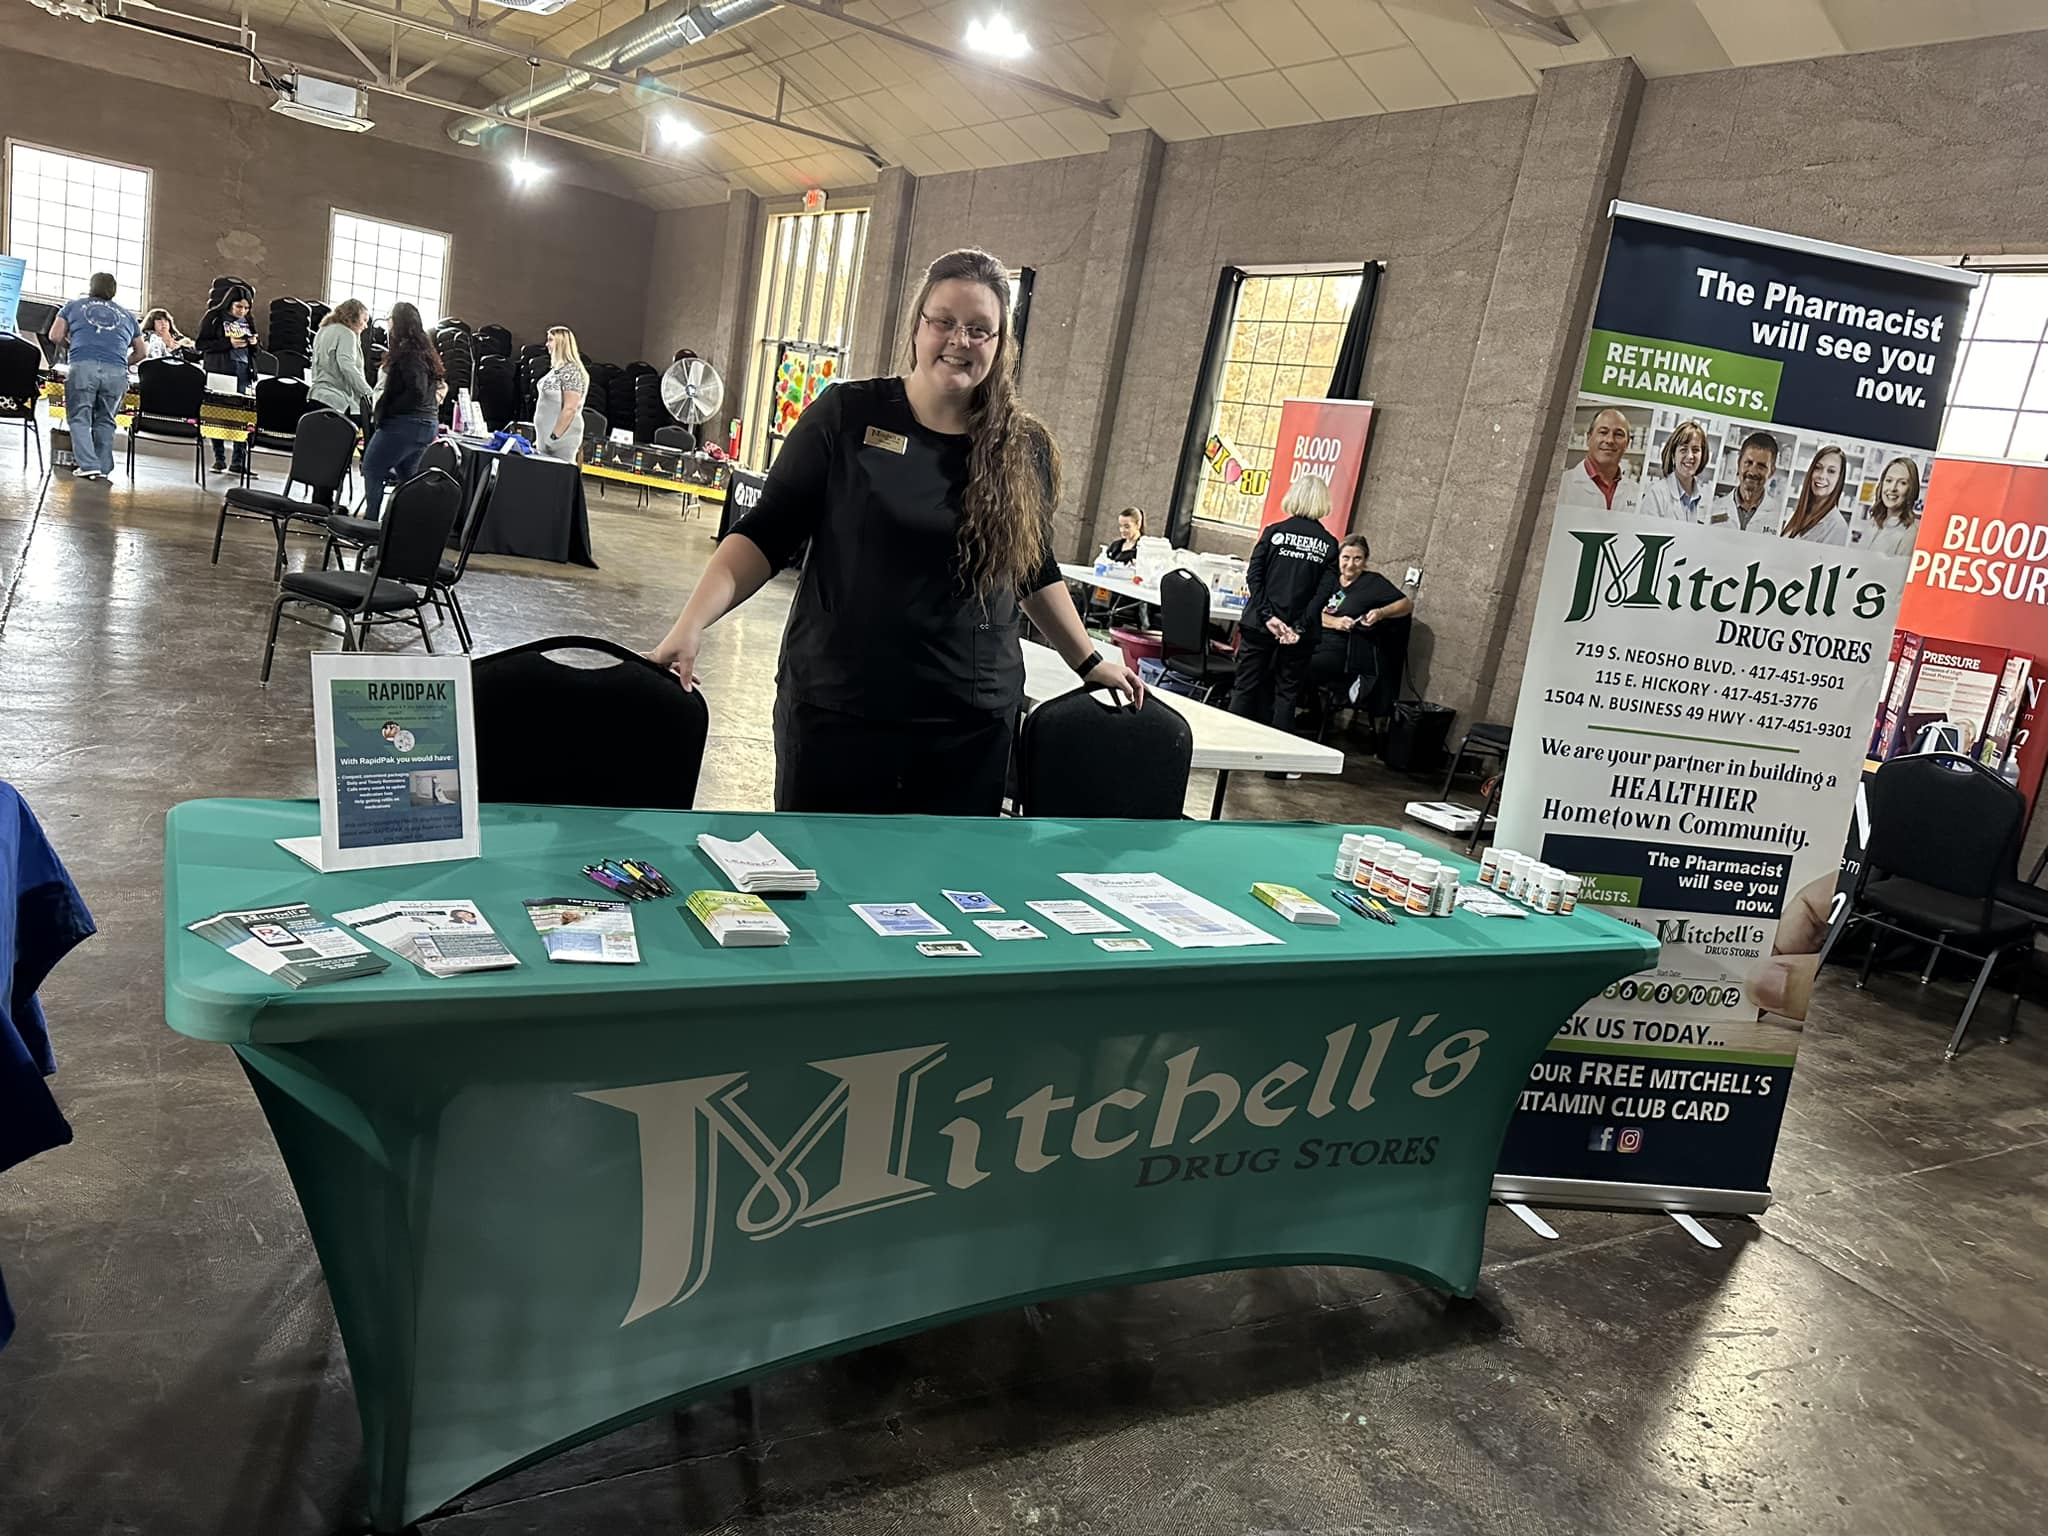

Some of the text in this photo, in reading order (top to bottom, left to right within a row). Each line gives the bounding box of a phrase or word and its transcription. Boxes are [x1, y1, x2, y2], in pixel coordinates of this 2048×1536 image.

[1696, 267, 1944, 343] The Pharmacist
[1606, 343, 1712, 378] RETHINK
[1751, 320, 1936, 376] will see you
[1601, 365, 1769, 412] PHARMACISTS.
[1856, 374, 1927, 409] now.
[1293, 435, 1341, 462] BLOOD
[1284, 532, 1330, 553] FREEMAN
[1943, 514, 2048, 562] BLOOD
[1564, 530, 1887, 623] Mitchell's
[1906, 549, 2048, 605] PRESSUR
[1716, 619, 1872, 664] DRUG STORES
[1575, 642, 1845, 690] 719 S. NEOSHO BLVD. 417-451-9501
[1921, 650, 1982, 670] PRESSURE
[368, 683, 447, 701] RAPIDPAK
[1595, 670, 1819, 711] 115 E. HICKORY 417-451-3776
[1544, 688, 1852, 739] 1504 N. BUSINESS 49 HWY 417-451-9301
[340, 758, 358, 766] With
[360, 757, 395, 766] RapidPak
[396, 757, 410, 765] you
[411, 755, 433, 763] would
[1541, 737, 1837, 791] We are your partner in building a
[1609, 774, 1758, 814] HEALTHIER
[1542, 798, 1810, 852] Hometown Community.
[1647, 851, 1783, 879] The Pharmacist
[1678, 874, 1779, 897] will see you
[1735, 898, 1775, 914] now.
[1656, 918, 1764, 945] Mitchell's
[1705, 945, 1760, 958] DRUG STORES
[1605, 982, 1739, 1005] 5 6 7 8 9 10 11 12
[1559, 1016, 1725, 1047] SK US TODAY...
[1529, 1061, 1772, 1096] OUR FREE MITCHELL'S
[1516, 1090, 1730, 1122] ITAMIN CLUB CARD
[571, 1013, 1491, 1328] Mitchell's
[1135, 1135, 1441, 1189] DRUG STORES
